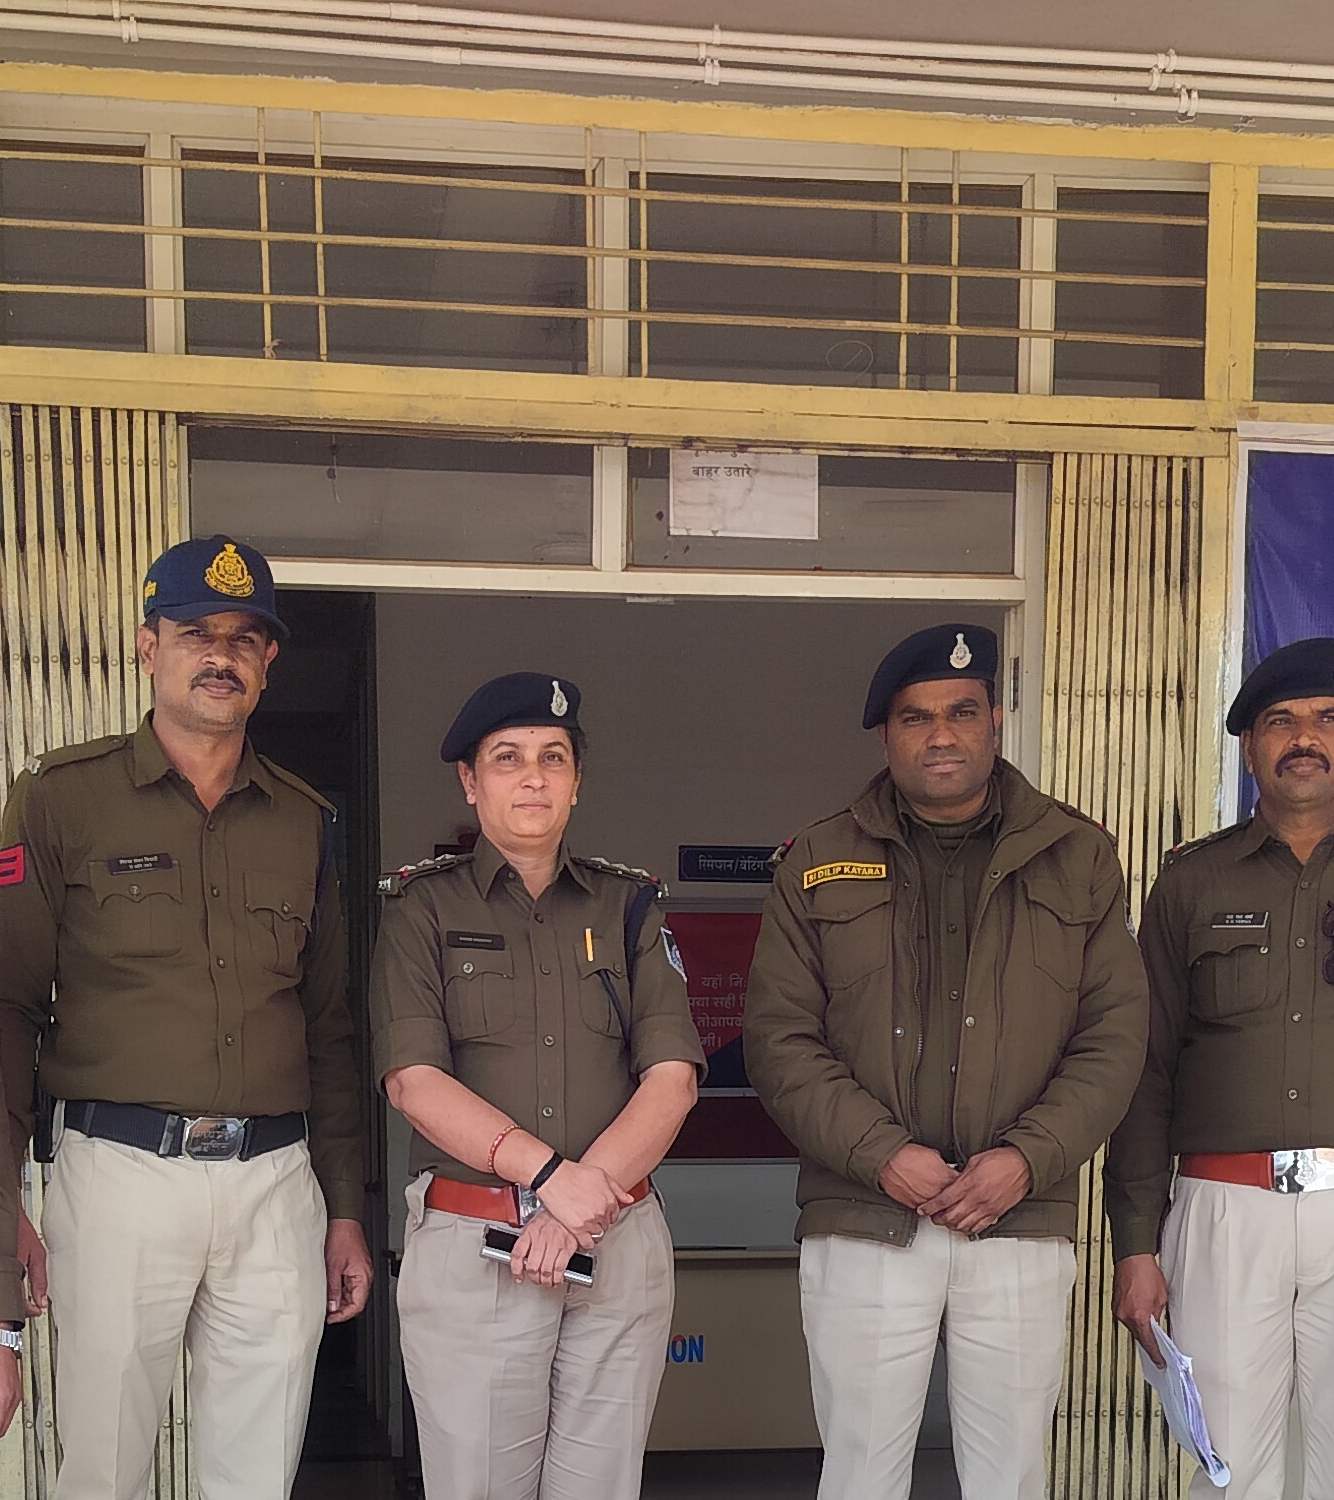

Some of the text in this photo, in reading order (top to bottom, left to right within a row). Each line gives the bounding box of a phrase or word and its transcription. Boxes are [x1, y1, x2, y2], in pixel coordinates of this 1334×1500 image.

[692, 466, 722, 481] बाहर
[808, 864, 881, 883] SI DILIP KATARA
